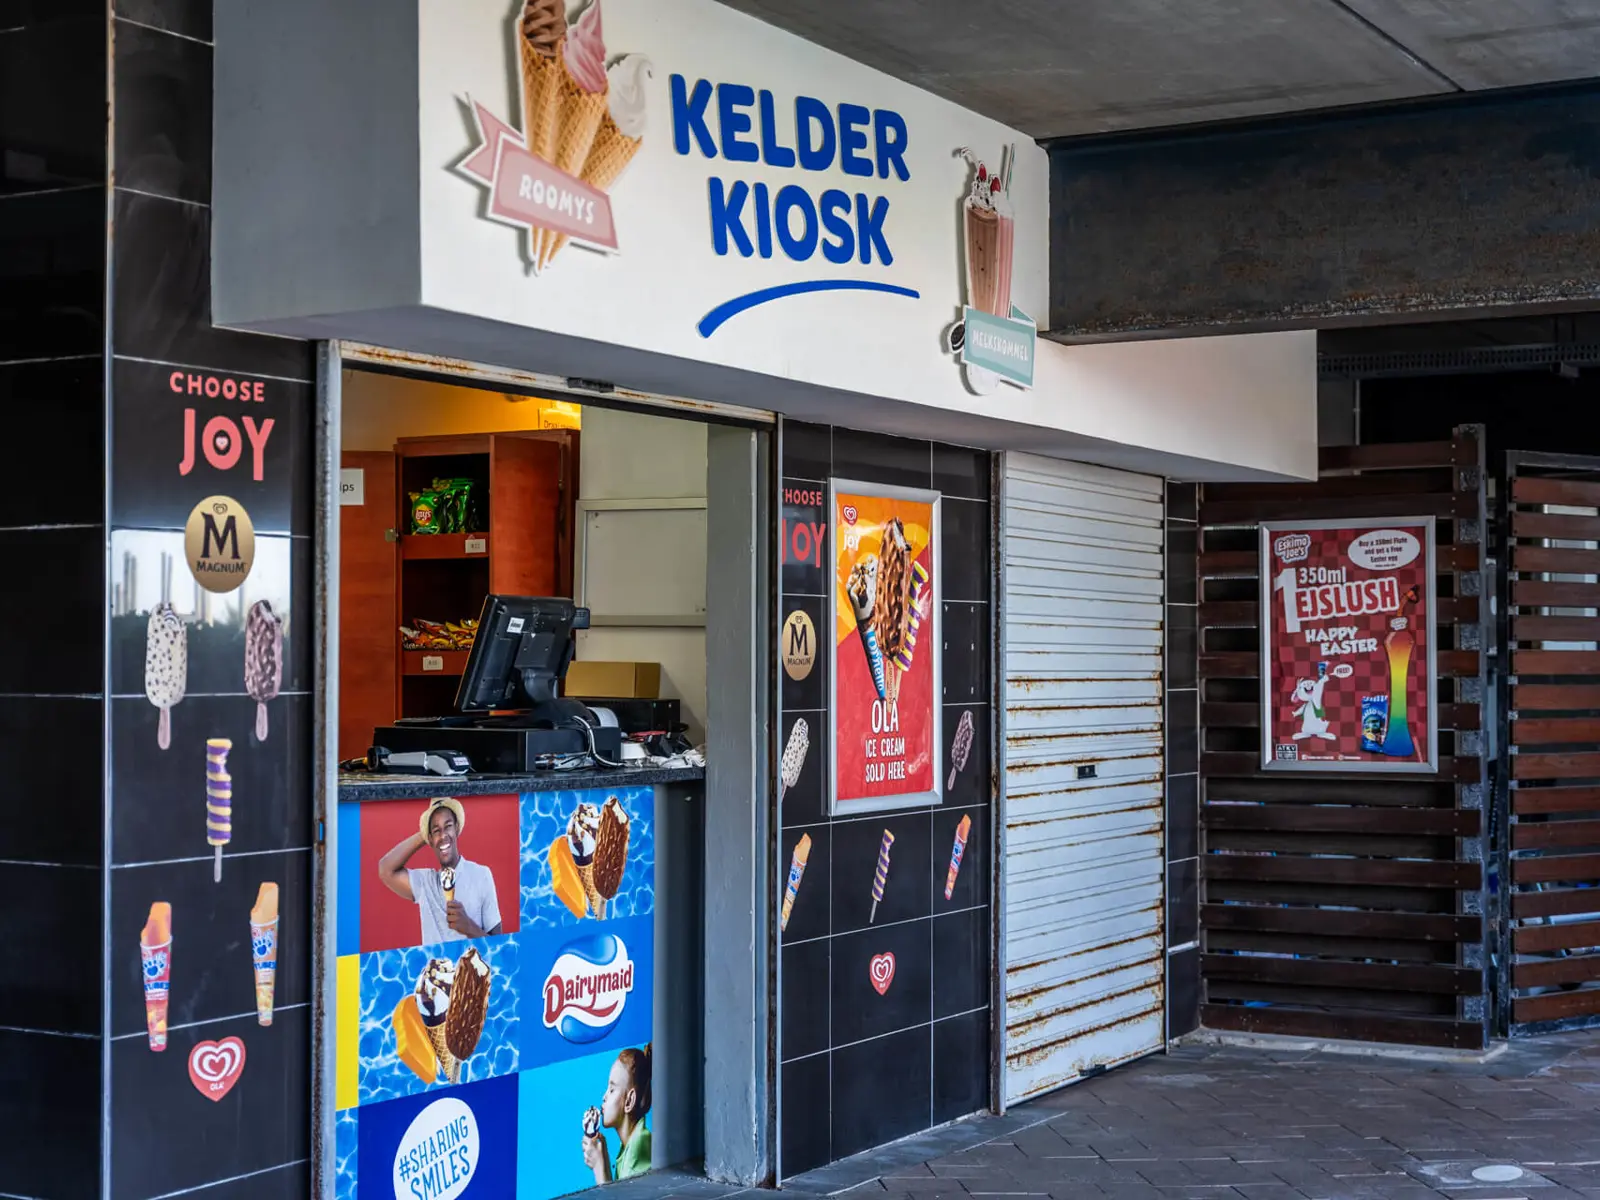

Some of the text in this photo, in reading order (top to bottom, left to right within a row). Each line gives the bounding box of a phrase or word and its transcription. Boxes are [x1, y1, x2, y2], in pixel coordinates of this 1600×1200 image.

[669, 73, 910, 181] KELDER
[519, 174, 595, 224] ROOMYS
[709, 177, 893, 266] KIOSK
[169, 371, 265, 402] CHOOSE
[179, 408, 275, 481] JOY
[782, 488, 822, 506] HOOSE
[201, 512, 241, 560] M
[782, 517, 826, 568] JOY
[1278, 537, 1307, 552] Eskimo
[196, 561, 246, 573] MAGNUM
[1274, 566, 1346, 633] 1 350ml
[789, 622, 809, 656] M
[1305, 626, 1358, 643] HAPPY
[1321, 638, 1378, 656] EASTER
[872, 699, 899, 733] OLA
[866, 737, 905, 758] ICE CREAM
[866, 761, 905, 783] SOLD HERE
[544, 963, 632, 1023] Dairymaid
[399, 1115, 468, 1182] #SHARING
[411, 1145, 470, 1200] SMILES
